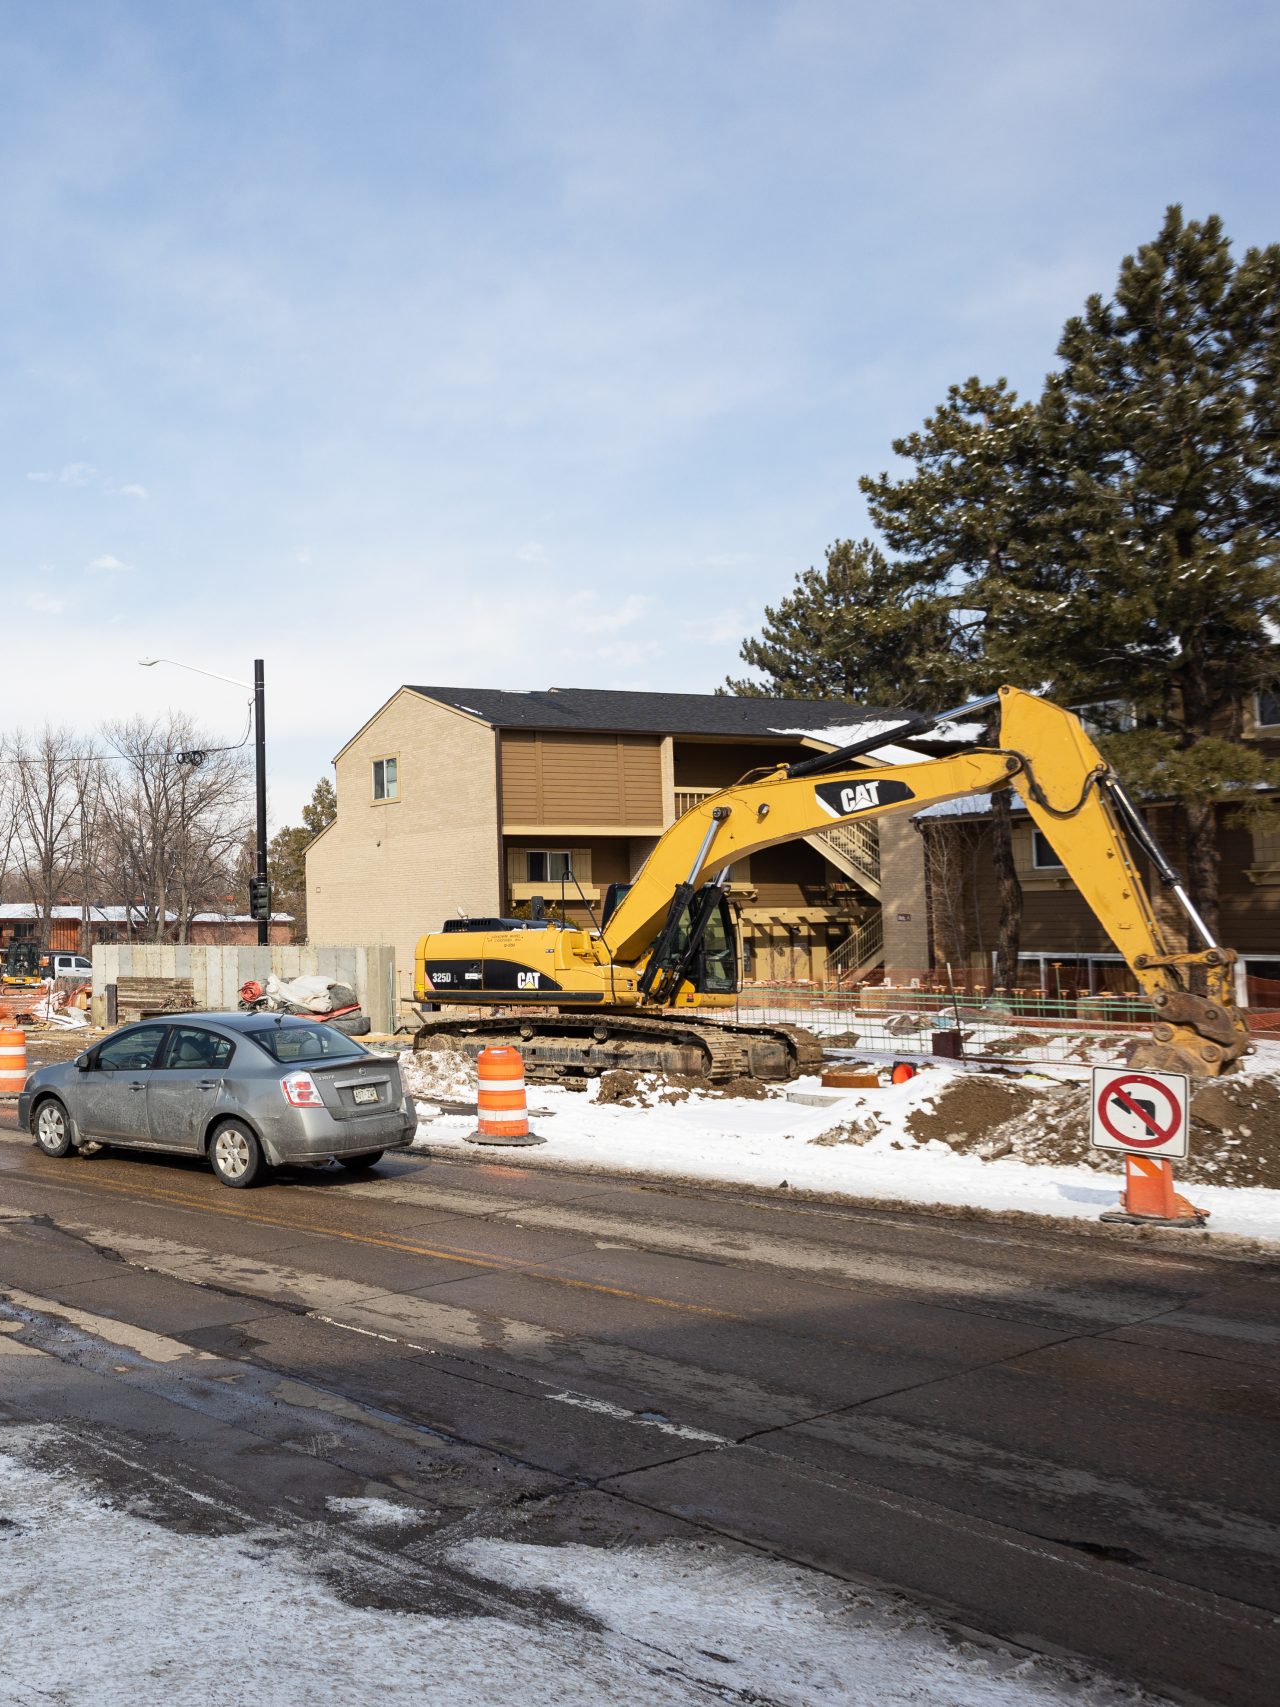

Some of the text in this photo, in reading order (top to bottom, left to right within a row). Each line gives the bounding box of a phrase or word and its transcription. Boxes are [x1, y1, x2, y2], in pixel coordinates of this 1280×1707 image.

[840, 781, 880, 812] CAT
[432, 972, 452, 983] 325D
[517, 972, 541, 989] CAT
